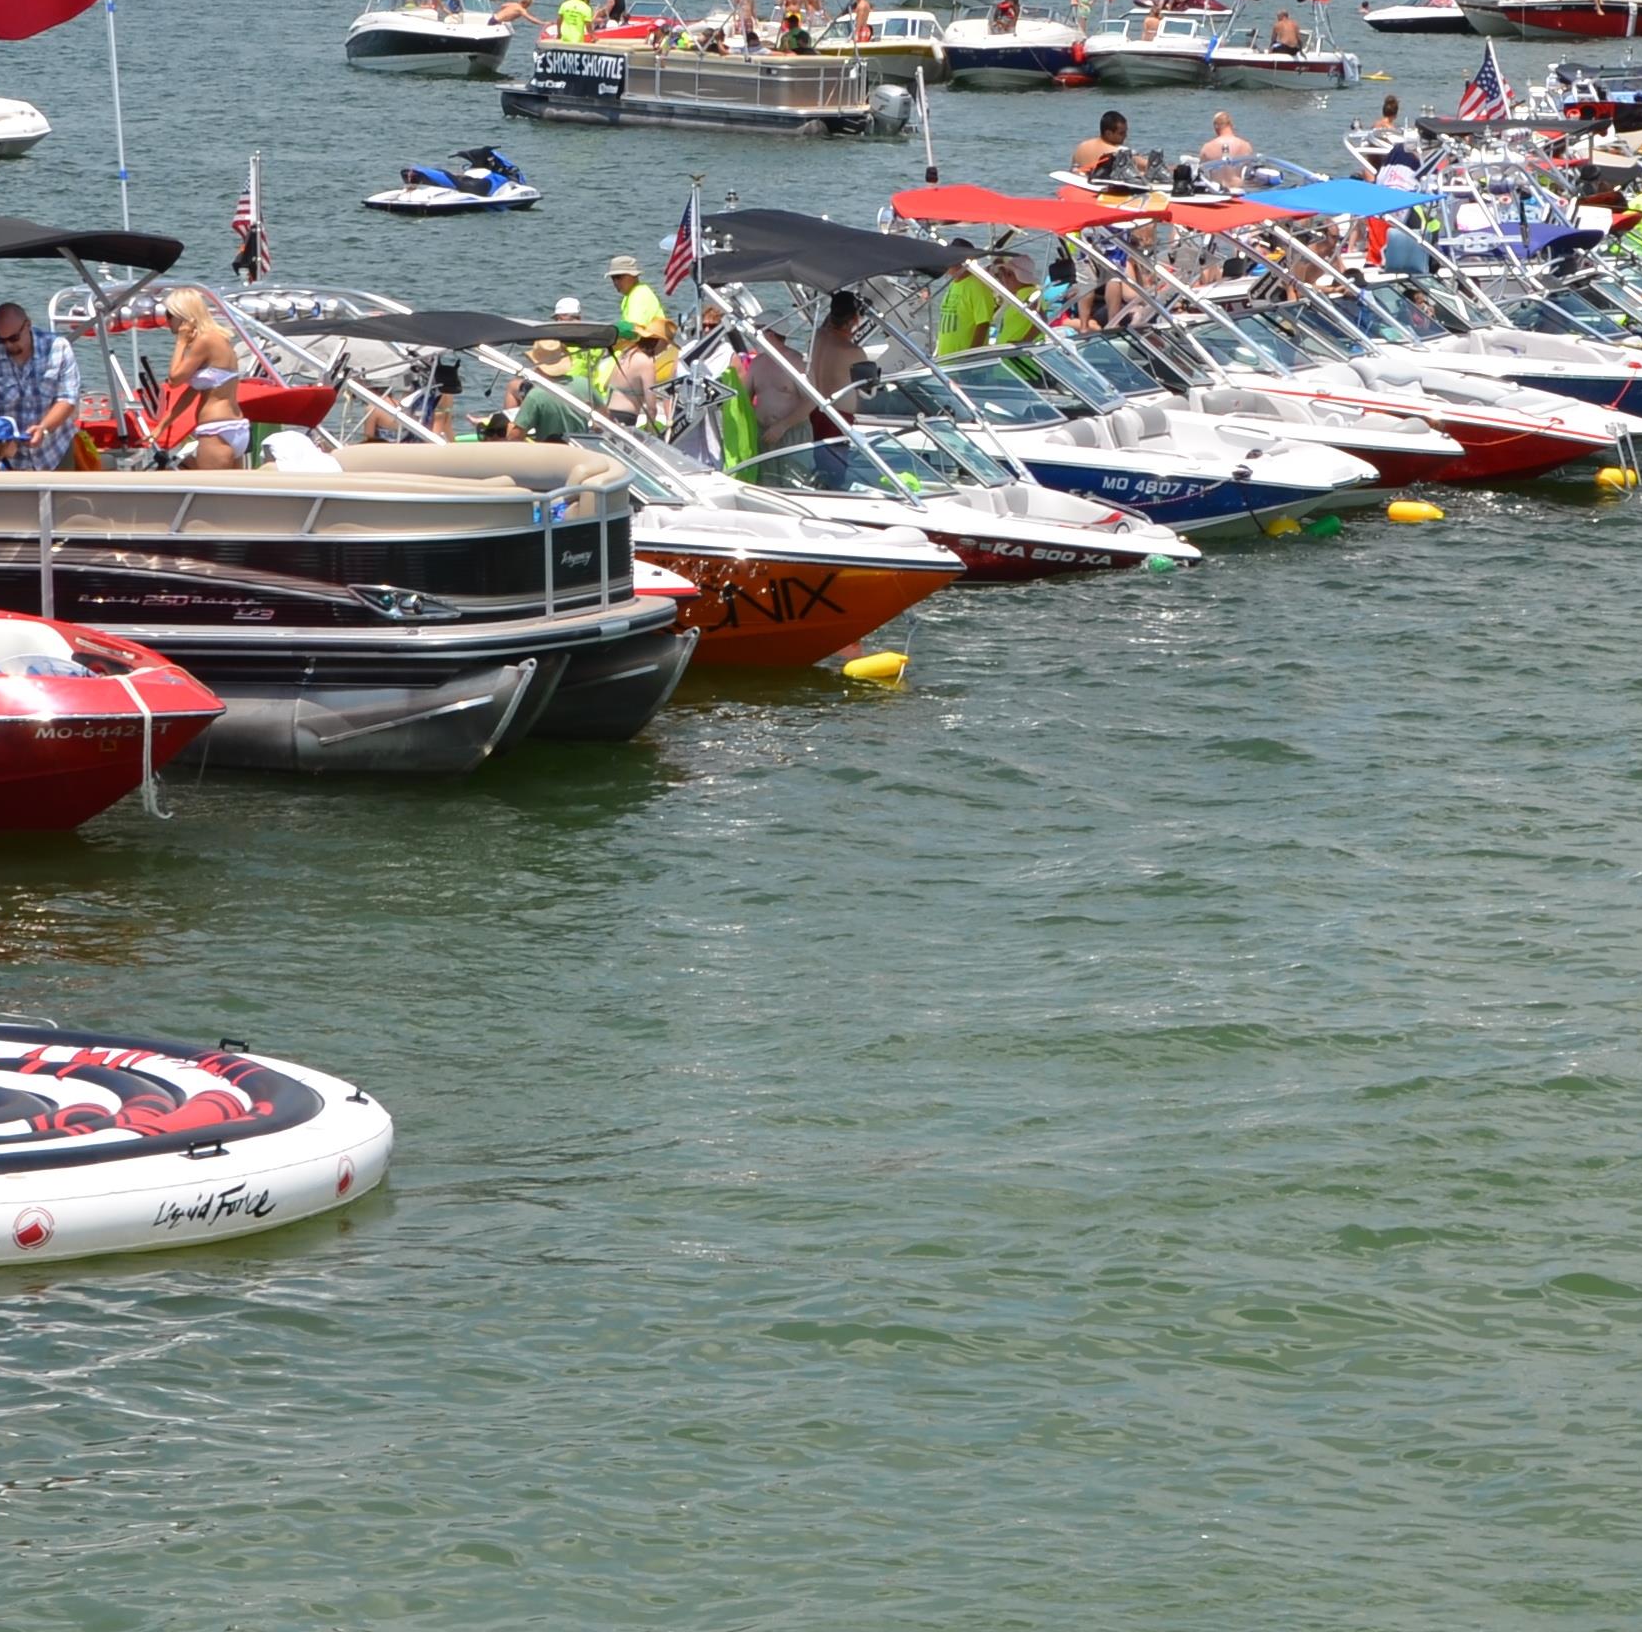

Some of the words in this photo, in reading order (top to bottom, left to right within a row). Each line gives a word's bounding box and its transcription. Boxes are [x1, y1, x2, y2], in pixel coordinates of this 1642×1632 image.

[545, 51, 581, 76] SHORE
[581, 53, 624, 80] SHUTTLE
[1102, 475, 1130, 491] MO
[991, 541, 1027, 560] KA
[1078, 552, 1113, 566] XA
[141, 594, 189, 607] 250
[152, 1191, 215, 1230] Liquid
[207, 1180, 277, 1227] Force
